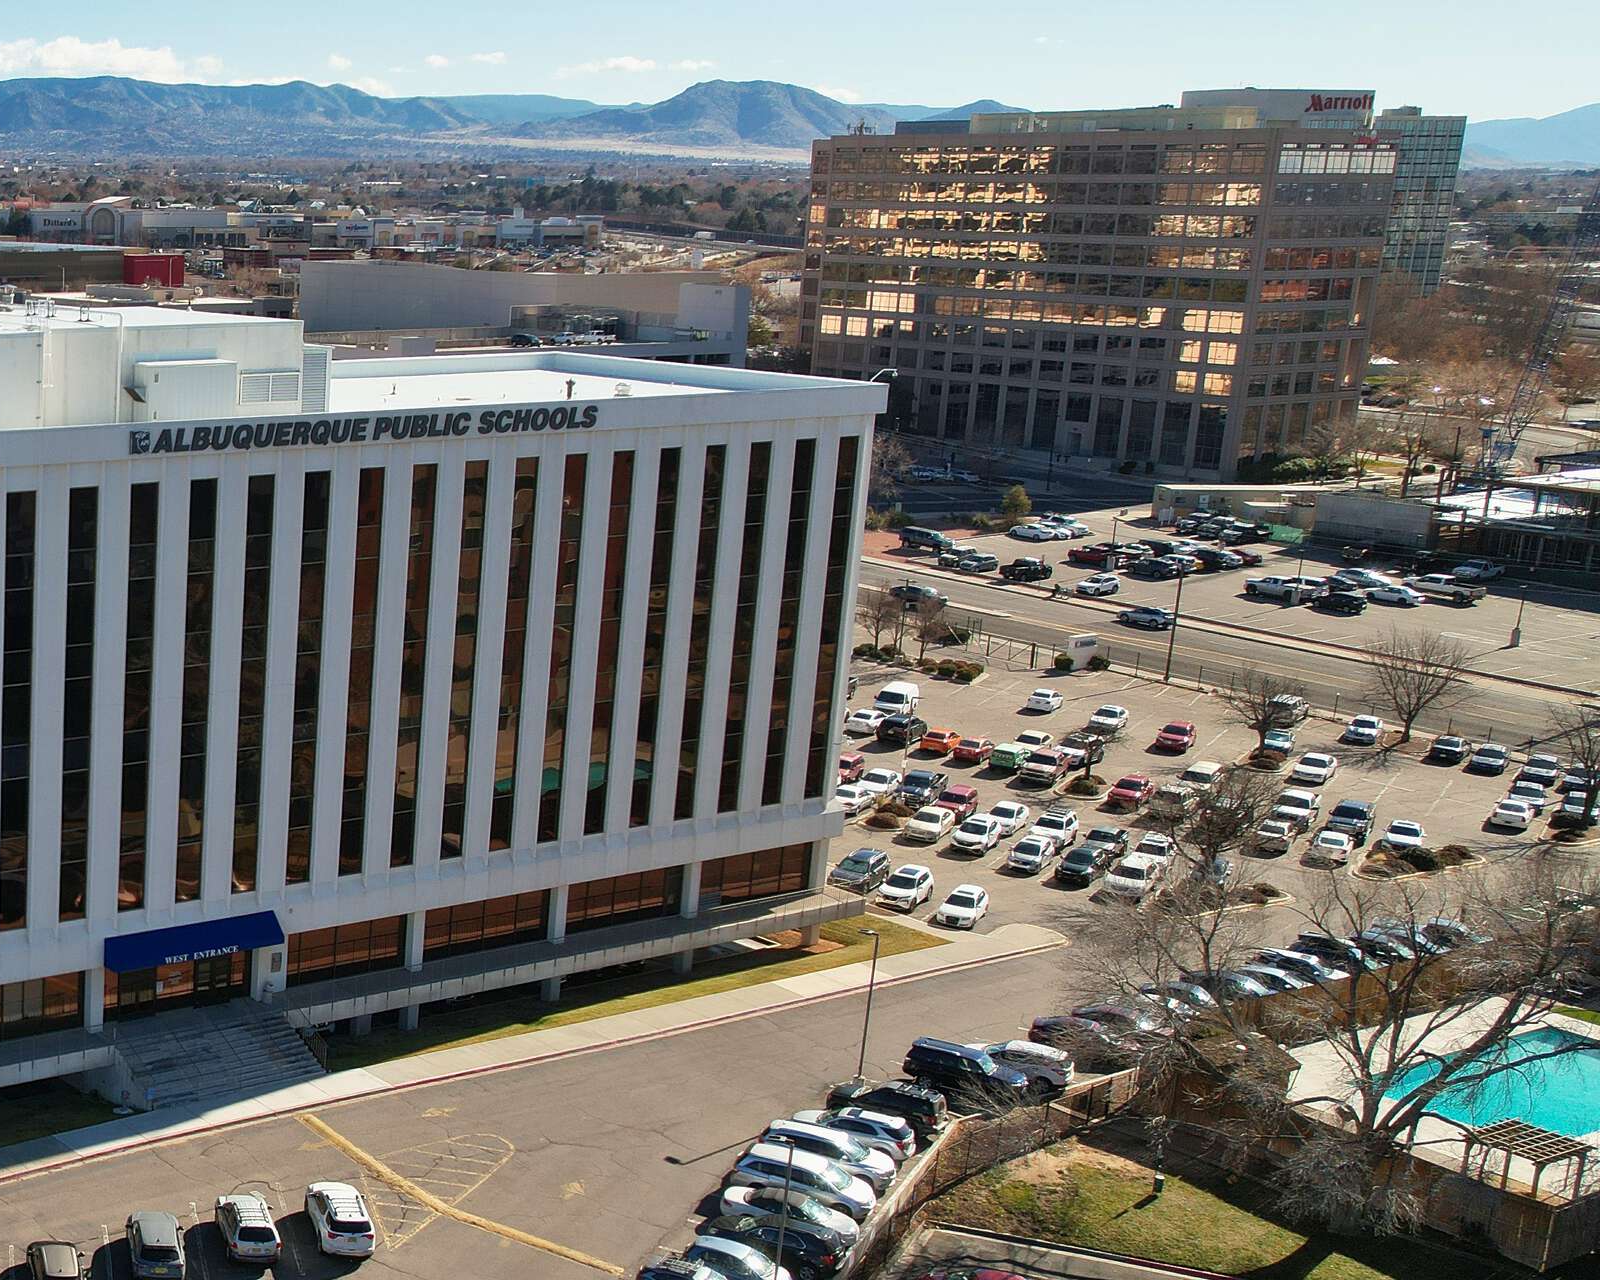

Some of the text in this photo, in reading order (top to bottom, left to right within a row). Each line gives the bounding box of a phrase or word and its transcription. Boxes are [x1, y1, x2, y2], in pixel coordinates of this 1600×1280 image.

[152, 405, 598, 453] ALBUQUERQUE PUBLIC SCHOOLS
[165, 945, 239, 965] WEST ENTRANCE
